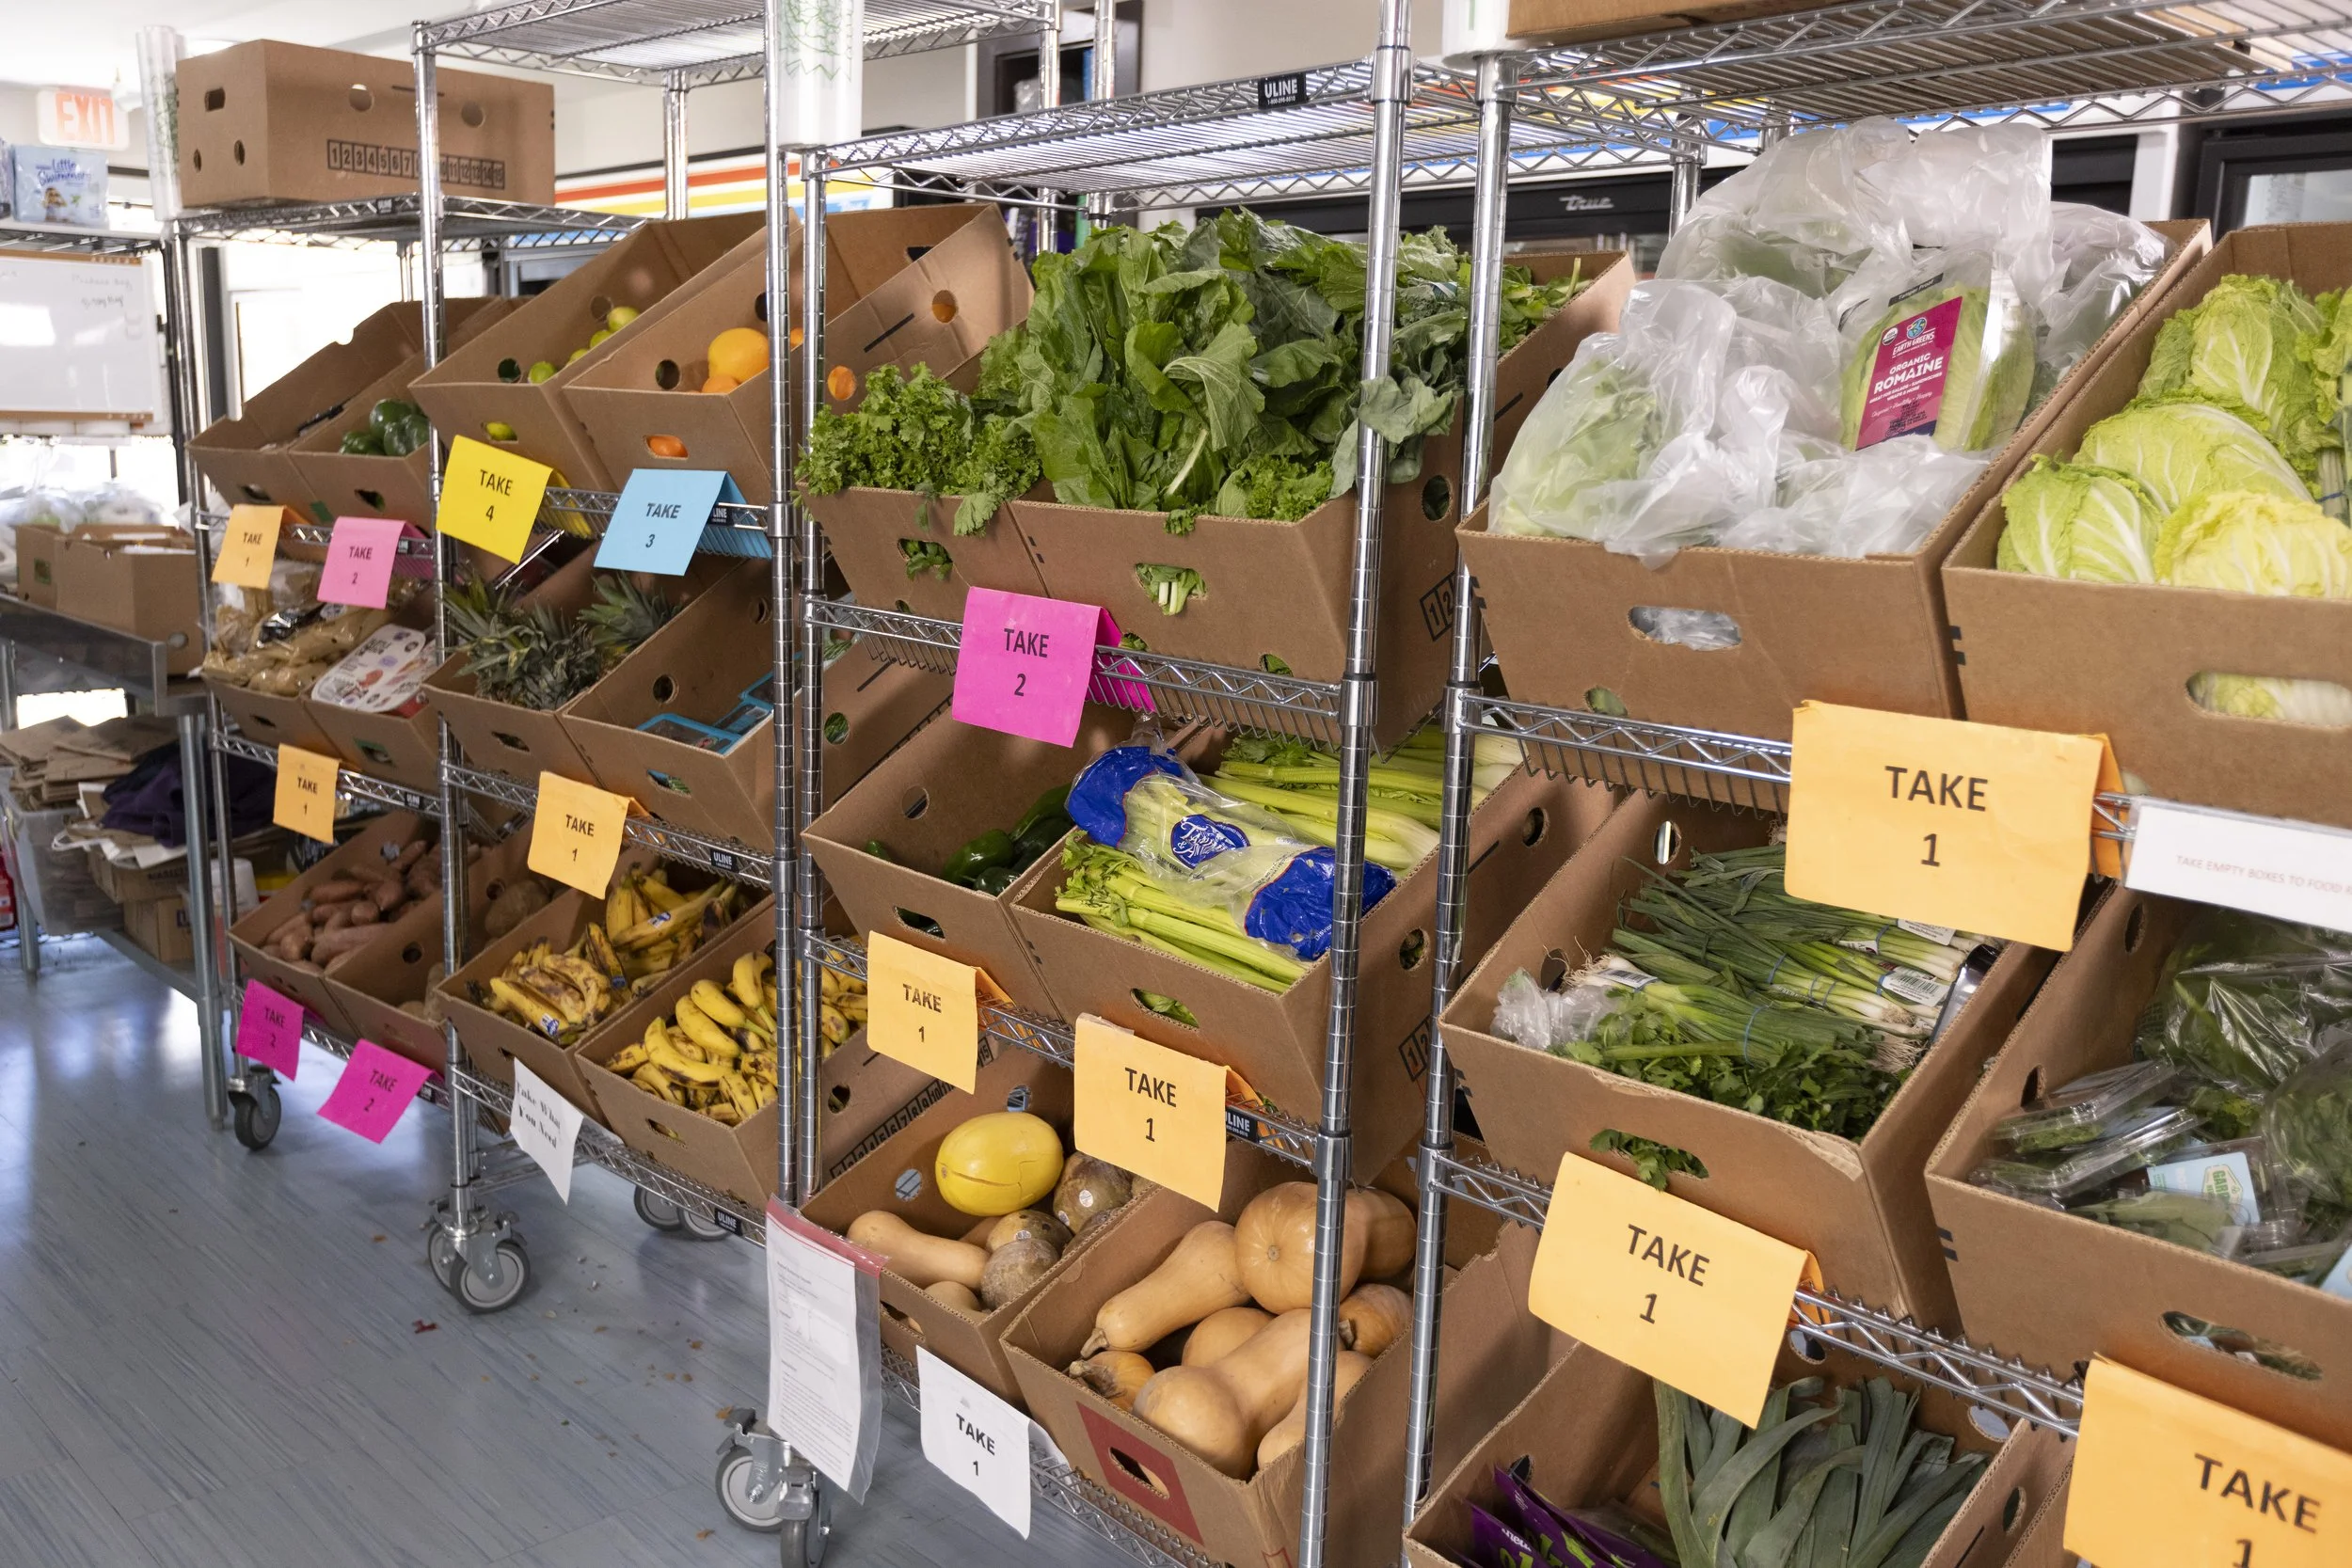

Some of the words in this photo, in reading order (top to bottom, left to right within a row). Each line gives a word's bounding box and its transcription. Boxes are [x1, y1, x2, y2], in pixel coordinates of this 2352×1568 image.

[1264, 78, 1297, 98] ULINE
[55, 92, 115, 144] EXIT
[332, 148, 338, 164] 1
[343, 149, 351, 165] 2
[356, 150, 363, 166] 3
[368, 152, 375, 167] 4
[380, 153, 388, 169] 5
[404, 156, 411, 171] 7
[450, 162, 457, 178] 11
[1893, 338, 1912, 356] EARTH
[1913, 331, 1935, 346] GREENS
[1874, 356, 1944, 394] ROMAINE
[1889, 353, 1931, 374] ORGANIC
[1891, 384, 1909, 394] SALADS
[1907, 385, 1920, 394] MORE
[481, 469, 513, 496] TAKE
[486, 505, 494, 521] 4
[646, 503, 681, 518] TAKE
[713, 508, 727, 518] LINE
[243, 531, 263, 546] TAKE
[645, 534, 655, 547] 3
[349, 546, 373, 561] TAKE
[1429, 602, 1440, 626] 1
[1442, 591, 1454, 617] 2
[1004, 628, 1049, 657] TAKE
[1014, 673, 1025, 696] 2
[298, 777, 317, 793] TAKE
[1885, 766, 1989, 812] TAKE
[566, 815, 594, 836] TAKE
[573, 848, 578, 862] 1
[1177, 841, 1186, 849] &
[1921, 833, 1940, 866] 1
[713, 852, 733, 865] ULINE
[2177, 855, 2202, 869] TAKE
[2206, 861, 2245, 877] EMPTY
[2249, 868, 2285, 884] BOXES
[2288, 875, 2305, 888] TO
[2307, 878, 2343, 894] FOOD
[903, 984, 941, 1013] TAKE
[264, 1006, 286, 1029] TAKE
[919, 1026, 924, 1042] 1
[979, 1044, 990, 1063] 15
[1407, 1046, 1419, 1068] 1
[370, 1069, 398, 1092] TAKE
[1125, 1068, 1176, 1107] TAKE
[516, 1081, 537, 1105] Take
[519, 1104, 536, 1128] You
[539, 1120, 557, 1148] Need
[1146, 1118, 1154, 1142] 1
[718, 1212, 737, 1228] ULINE
[1629, 1224, 1710, 1287] TAKE
[1640, 1293, 1657, 1324] 1
[957, 1414, 994, 1455] TAKE
[974, 1461, 978, 1476] 1
[2195, 1453, 2321, 1534] TAKE
[2233, 1539, 2252, 1568] 1
